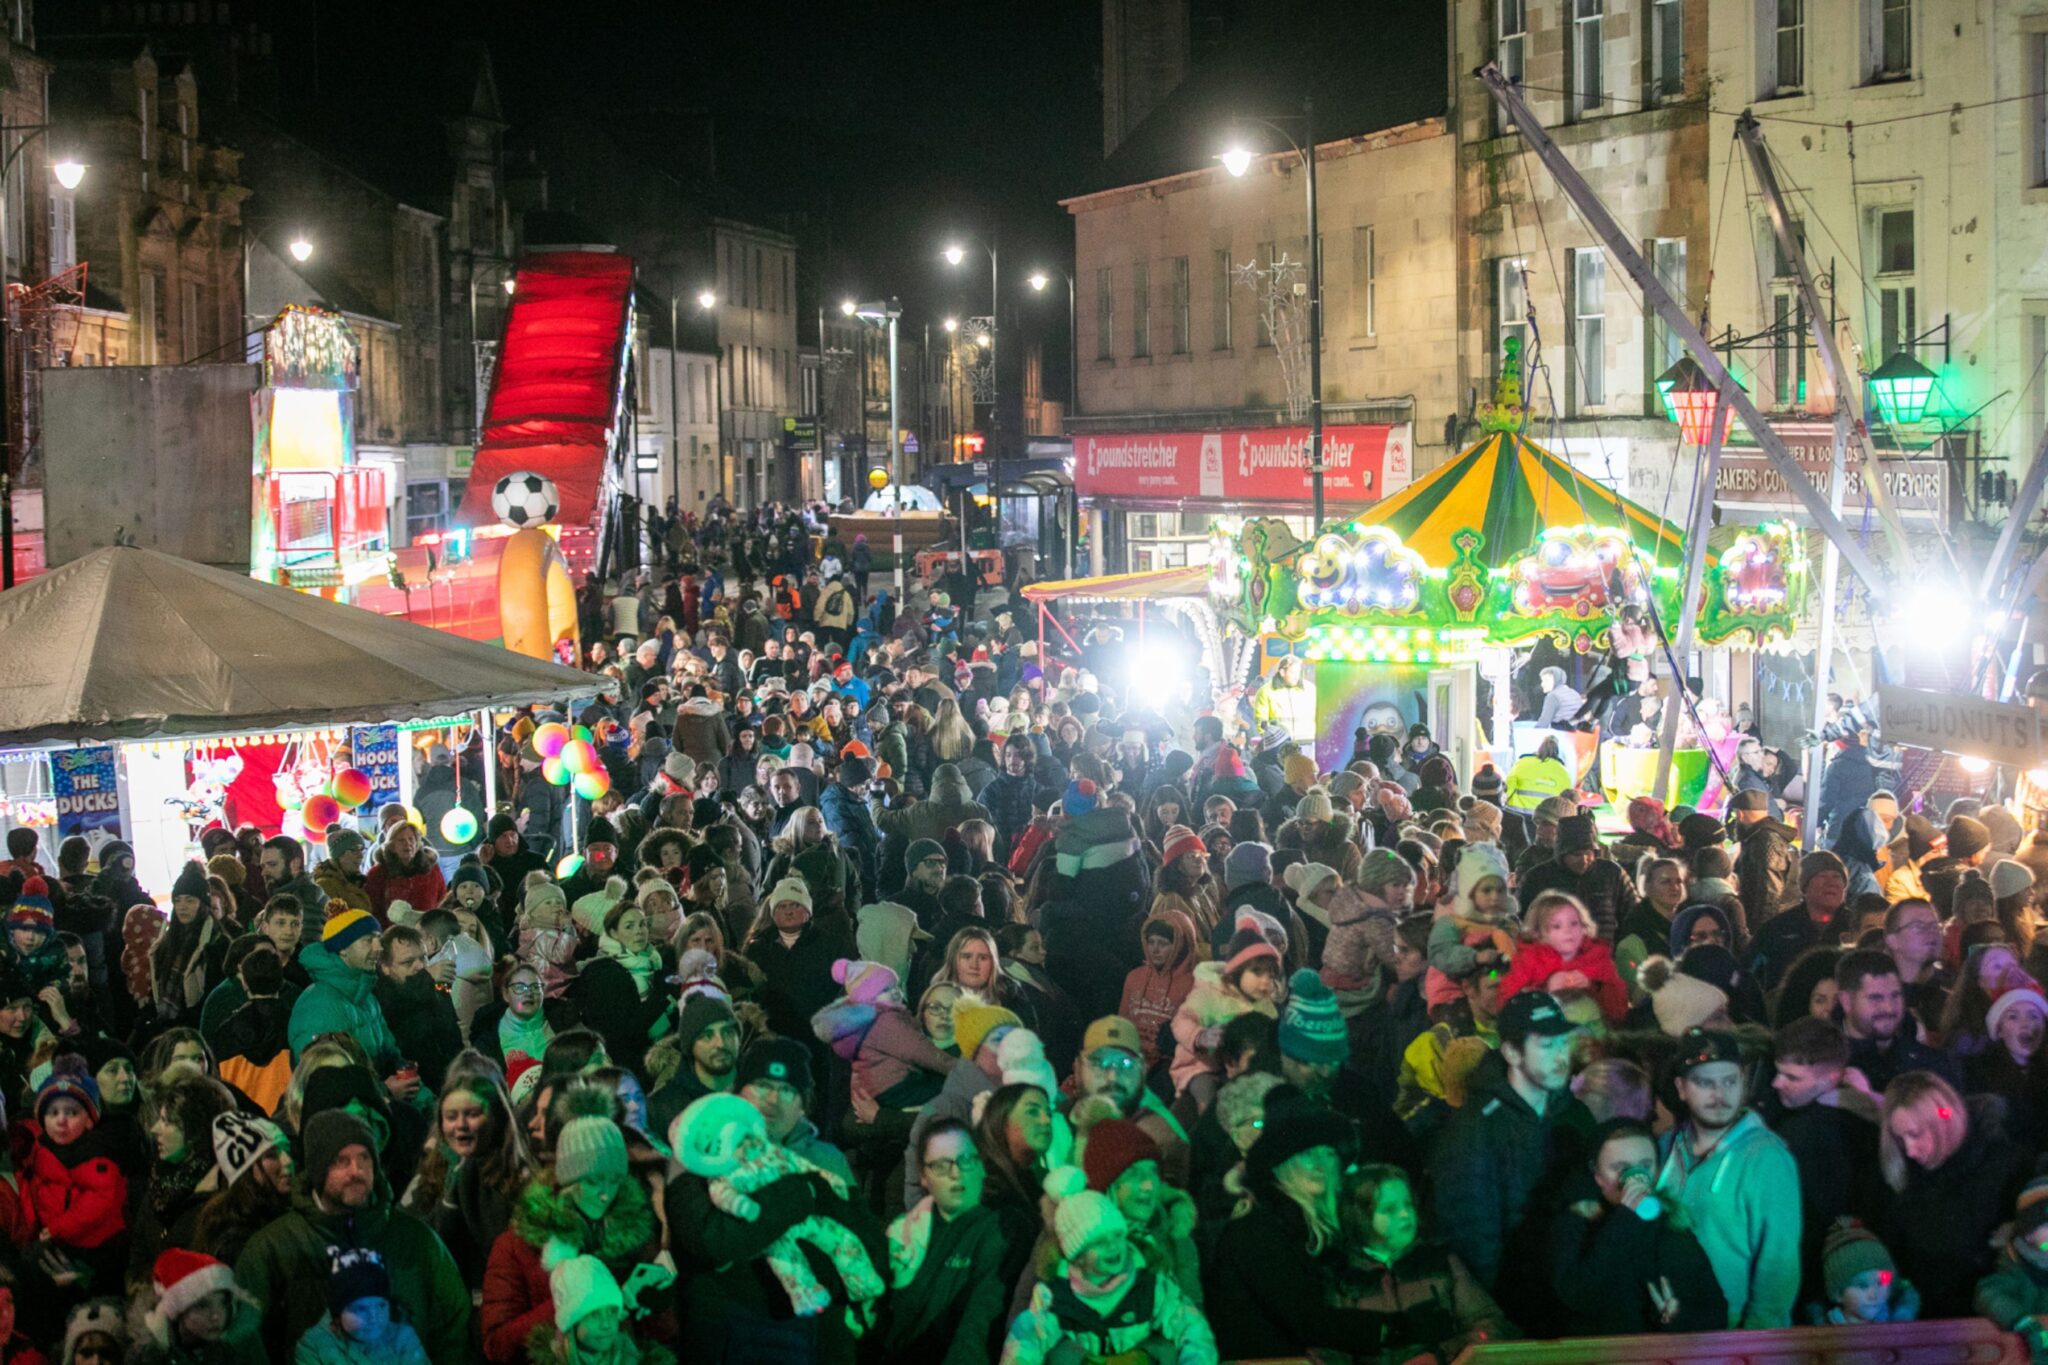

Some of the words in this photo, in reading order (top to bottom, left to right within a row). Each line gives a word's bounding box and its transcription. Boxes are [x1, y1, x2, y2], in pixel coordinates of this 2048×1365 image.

[1715, 467, 1756, 491] BAKERS
[1927, 703, 2028, 749] DONUTS
[356, 750, 398, 766] HOOK
[72, 774, 100, 790] THE
[369, 775, 398, 791] UCK
[58, 793, 118, 815] DUCKS
